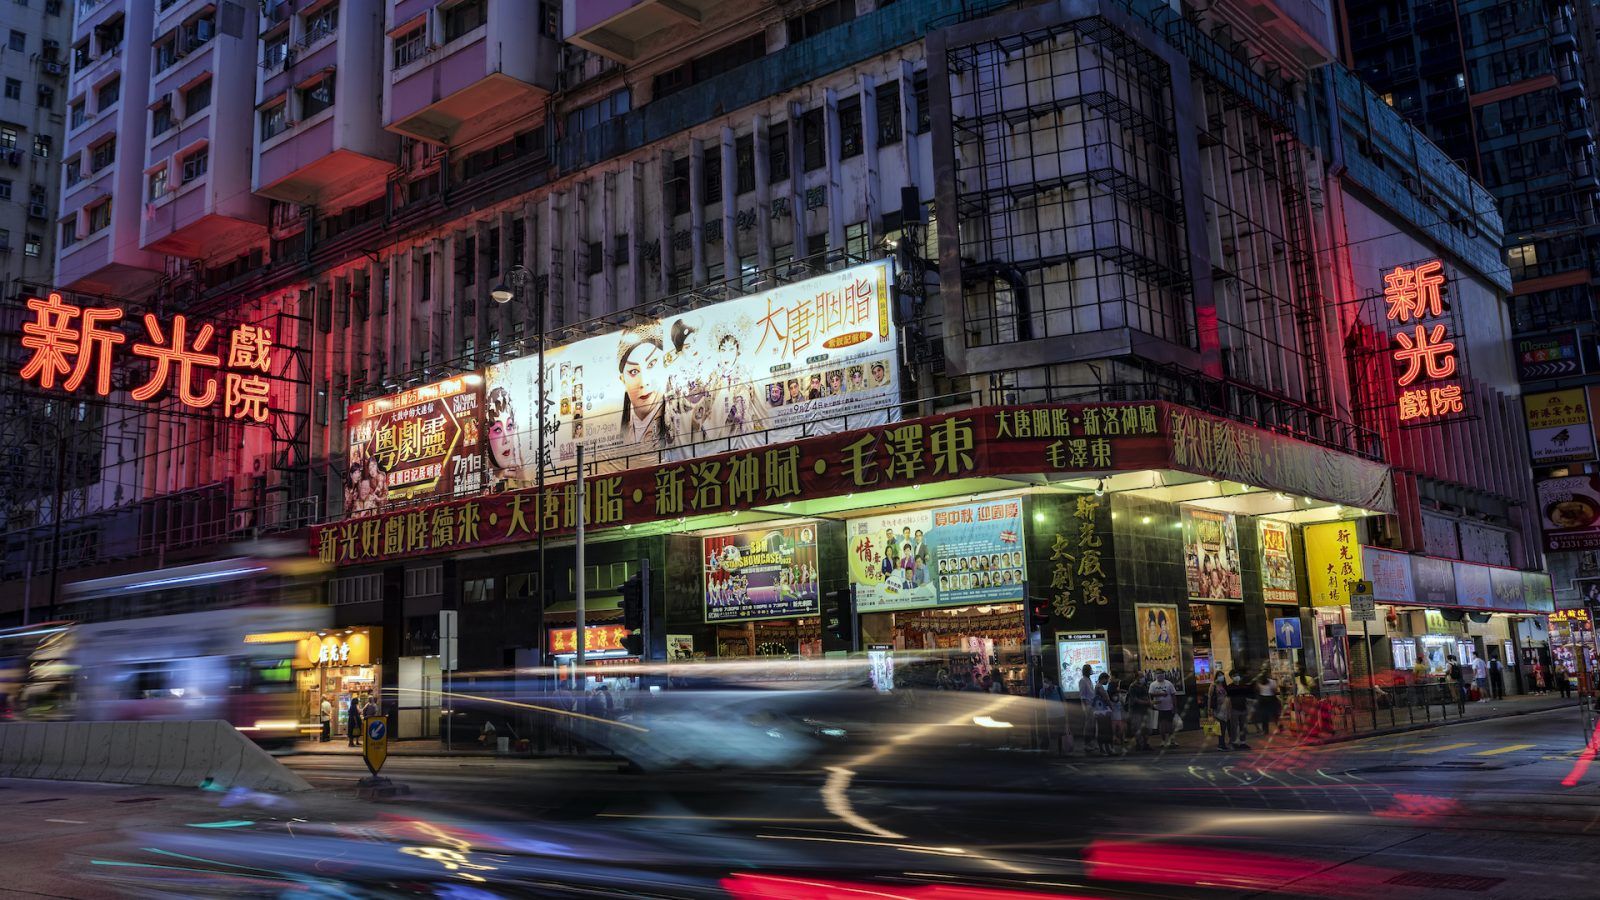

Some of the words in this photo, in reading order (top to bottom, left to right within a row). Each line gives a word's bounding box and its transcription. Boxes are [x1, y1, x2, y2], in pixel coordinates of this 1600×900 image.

[754, 277, 874, 360] 大唐胭脂
[1384, 261, 1455, 386] 新光
[20, 293, 221, 408] 新光
[224, 323, 273, 423] 戲院
[995, 408, 1071, 439] 大唐胭脂
[1082, 404, 1158, 436] 新洛神賦
[1400, 385, 1463, 420] 戲院
[452, 453, 481, 475] 7月1日
[1046, 438, 1112, 468] 毛澤東
[318, 501, 481, 564] 新光好戲陸續來
[506, 476, 624, 538] 大唐胭脂
[654, 444, 802, 515] 新洛神賦
[840, 417, 975, 487] 毛澤東
[935, 508, 973, 527] 賀中秋
